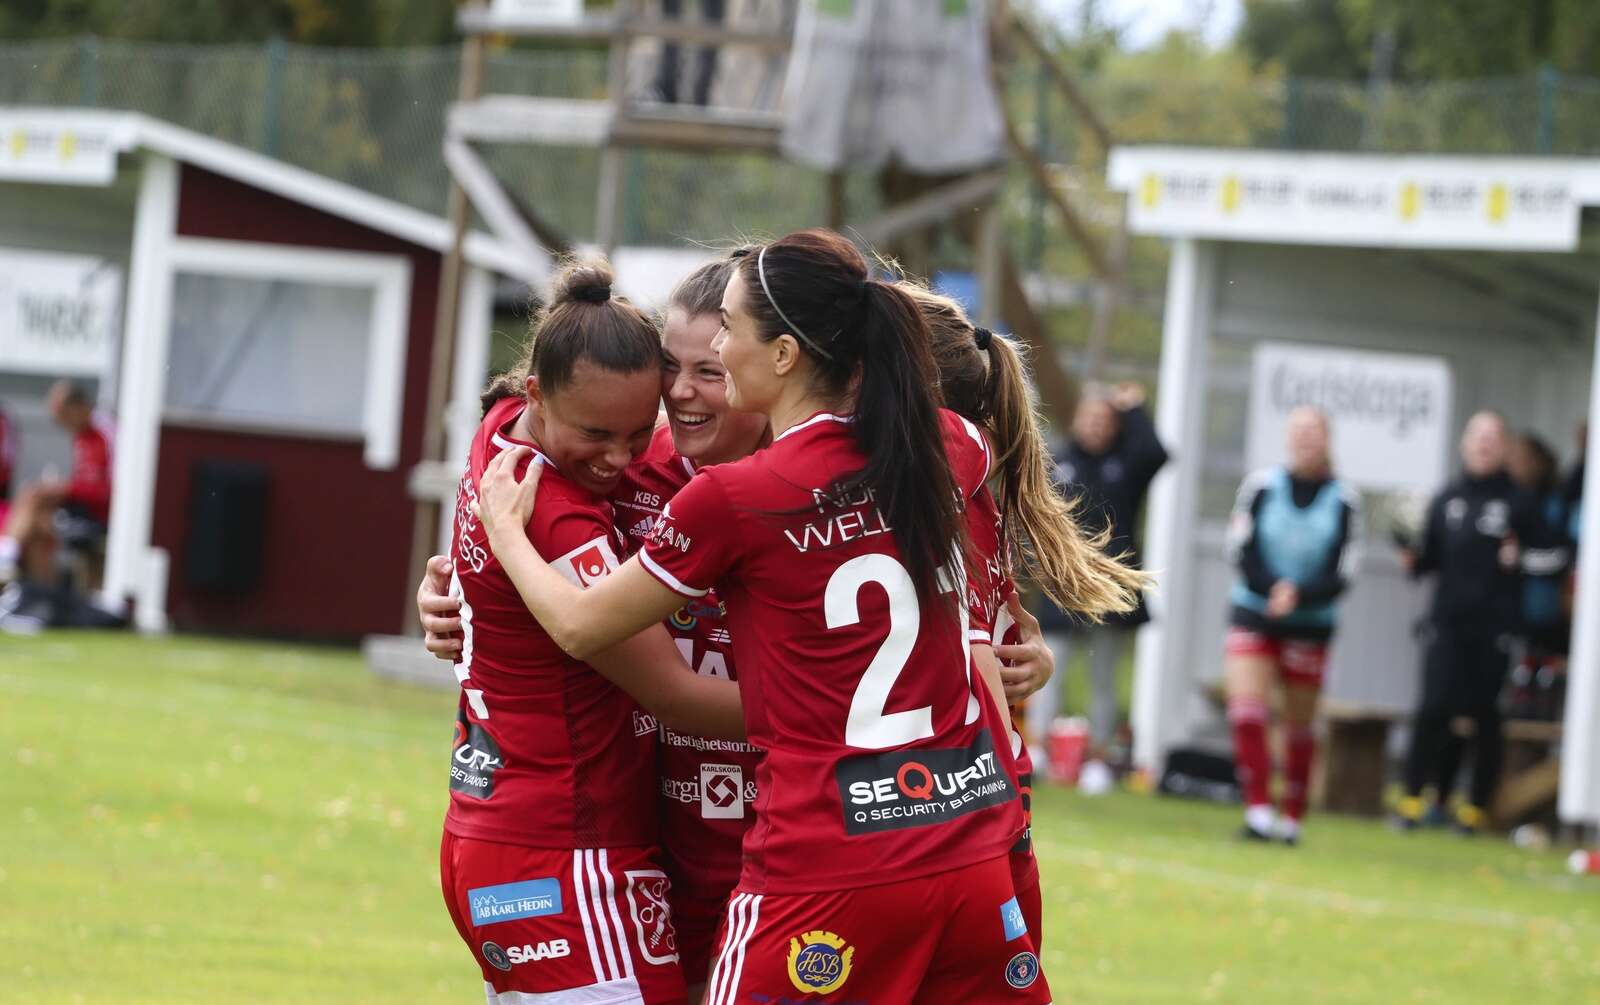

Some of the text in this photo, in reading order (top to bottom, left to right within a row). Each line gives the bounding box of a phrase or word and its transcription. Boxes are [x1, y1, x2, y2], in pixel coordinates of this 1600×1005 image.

[634, 490, 660, 507] KBS
[701, 766, 741, 774] KARLSKOGA
[744, 781, 758, 800] &
[855, 811, 867, 823] Q
[871, 802, 946, 820] SECURITY
[479, 899, 553, 918] AB KARL HEDIN
[506, 938, 570, 964] SAAB
[798, 951, 840, 975] HSB
